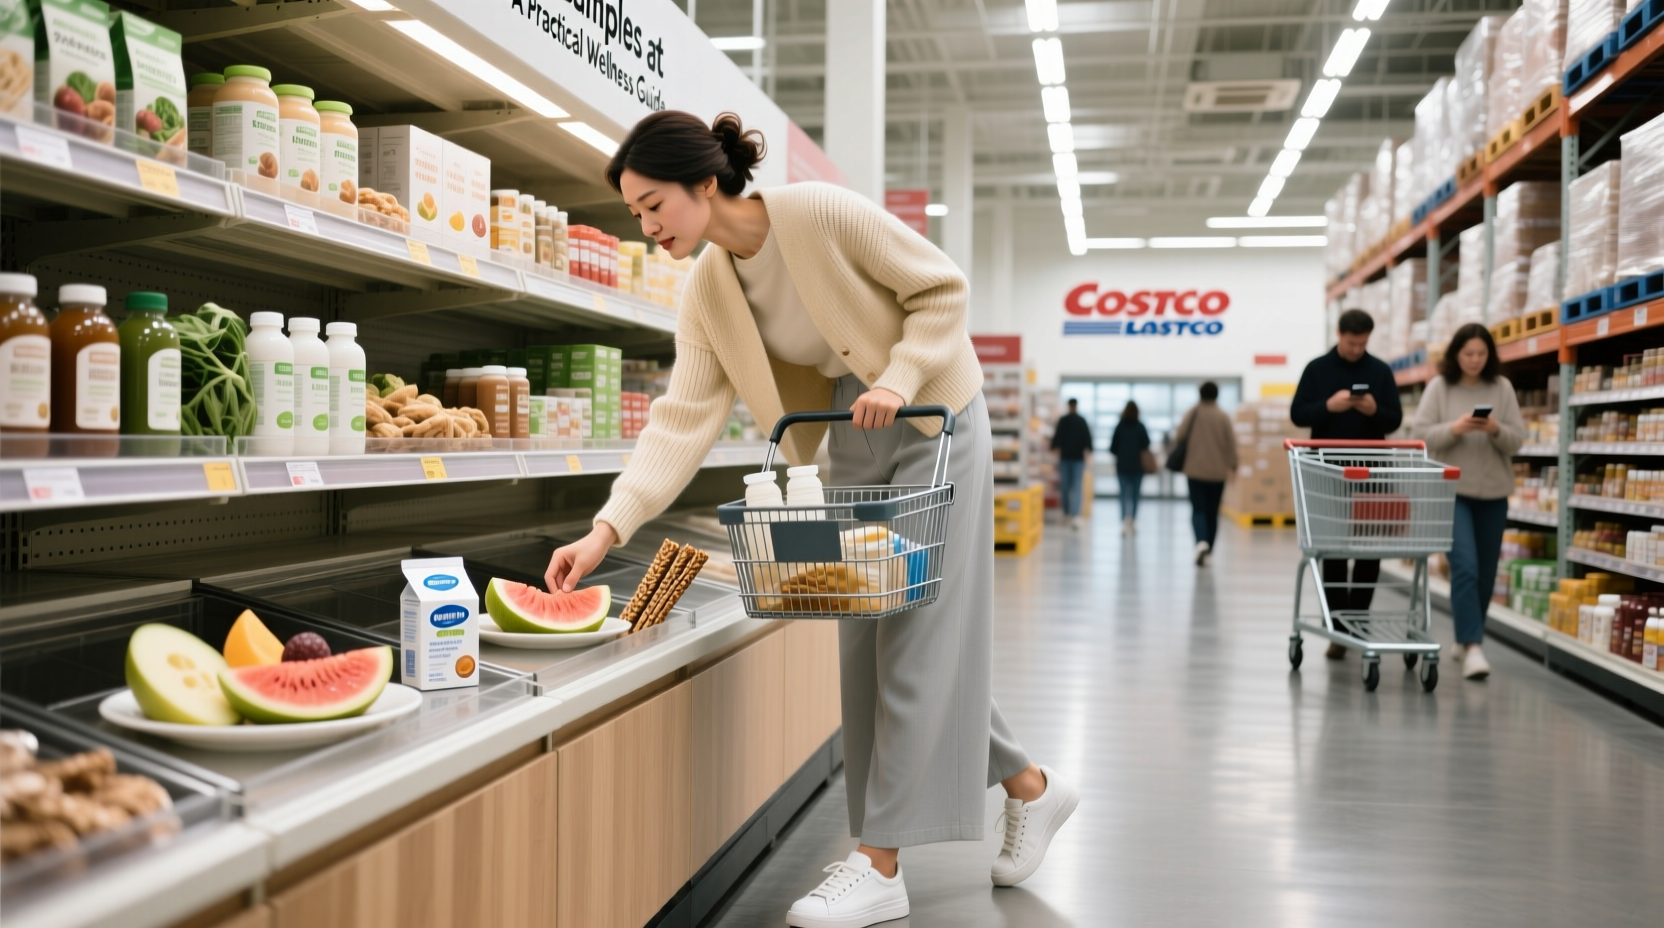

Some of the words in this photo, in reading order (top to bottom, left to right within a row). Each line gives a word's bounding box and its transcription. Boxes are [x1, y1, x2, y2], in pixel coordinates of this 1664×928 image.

[527, 0, 583, 58] Practical
[586, 35, 634, 96] Wellness
[564, 0, 643, 59] mples
[646, 37, 664, 79] at
